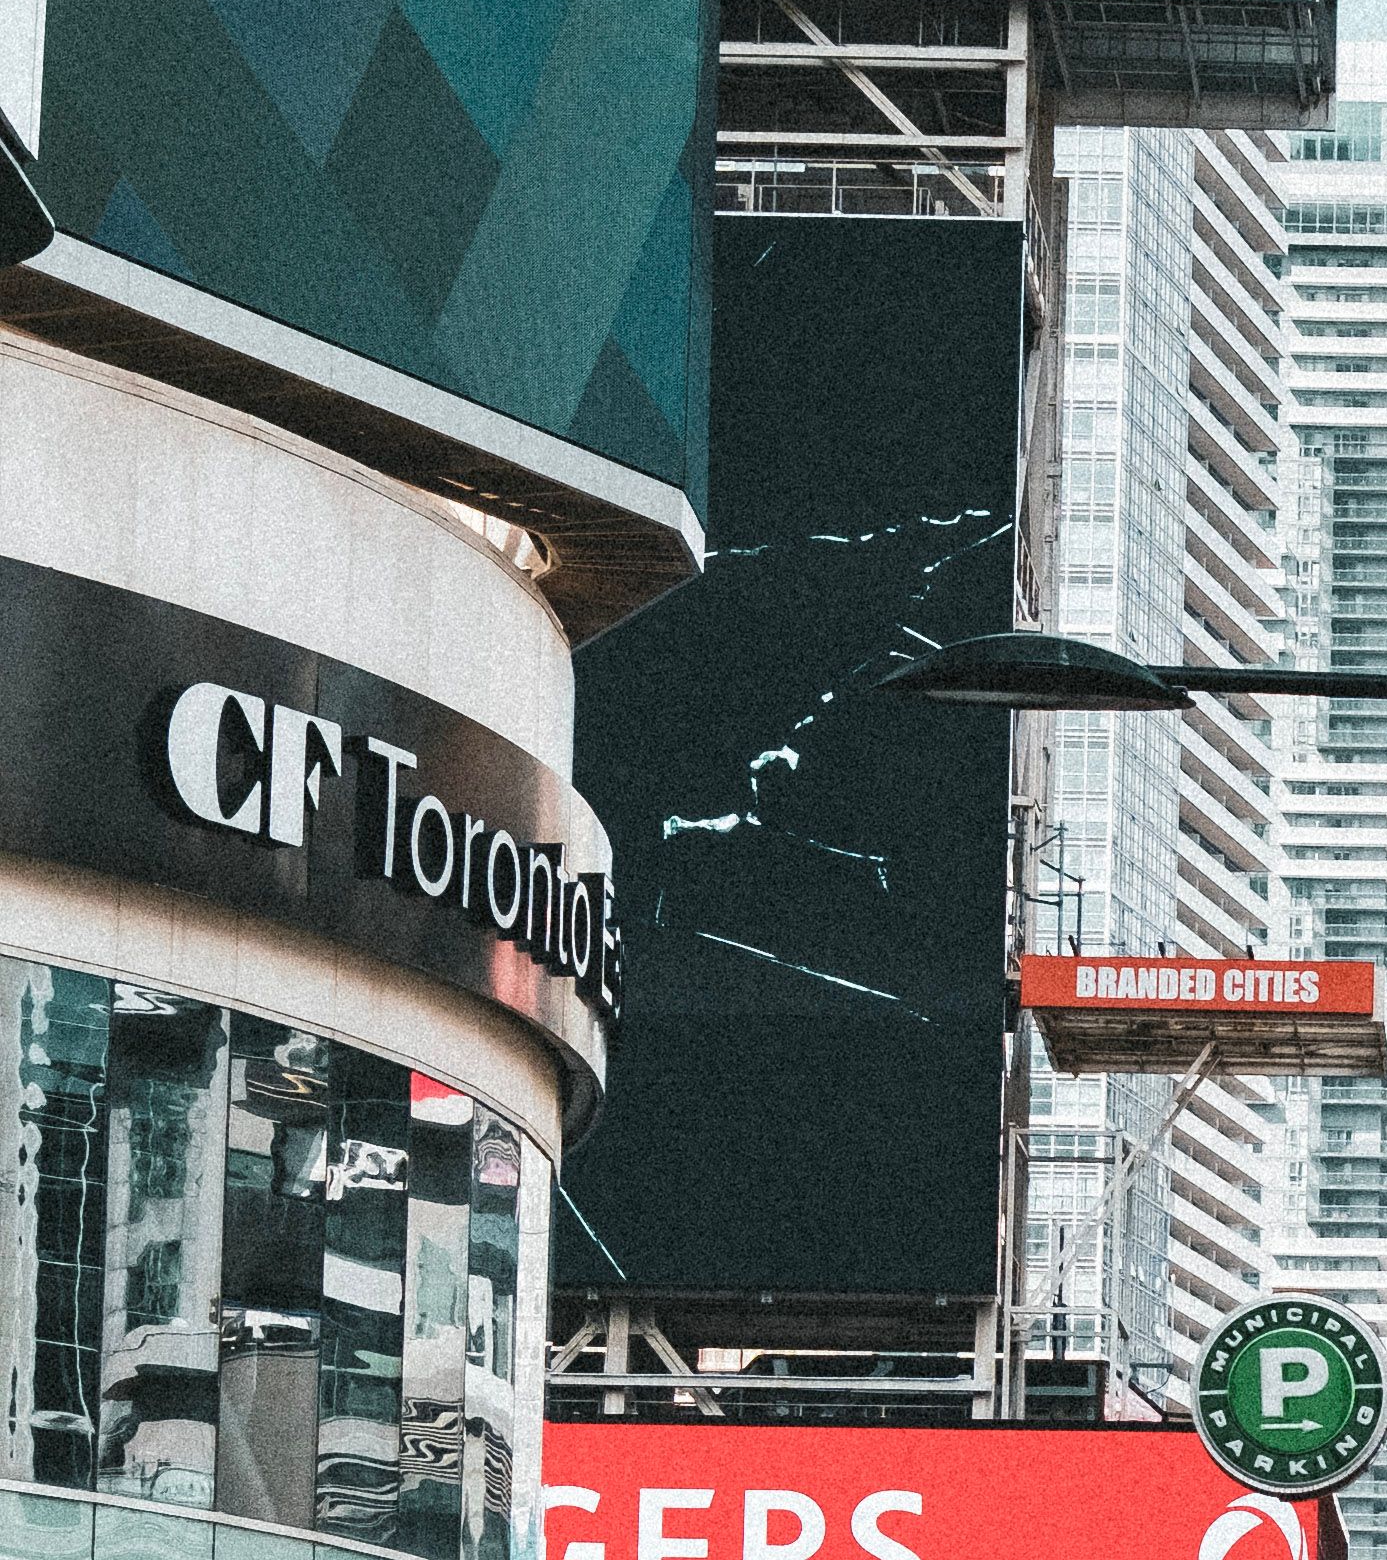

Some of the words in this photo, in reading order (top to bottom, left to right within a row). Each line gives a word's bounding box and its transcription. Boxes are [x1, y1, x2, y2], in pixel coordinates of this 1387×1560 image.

[168, 682, 342, 848] CF
[367, 737, 592, 978] Toronto
[1075, 966, 1216, 1002] BRANDED
[1222, 968, 1320, 1005] CITIES
[1211, 1307, 1368, 1372] MUNICIPAL
[1259, 1347, 1330, 1417] P
[1209, 1404, 1375, 1476] PARKING
